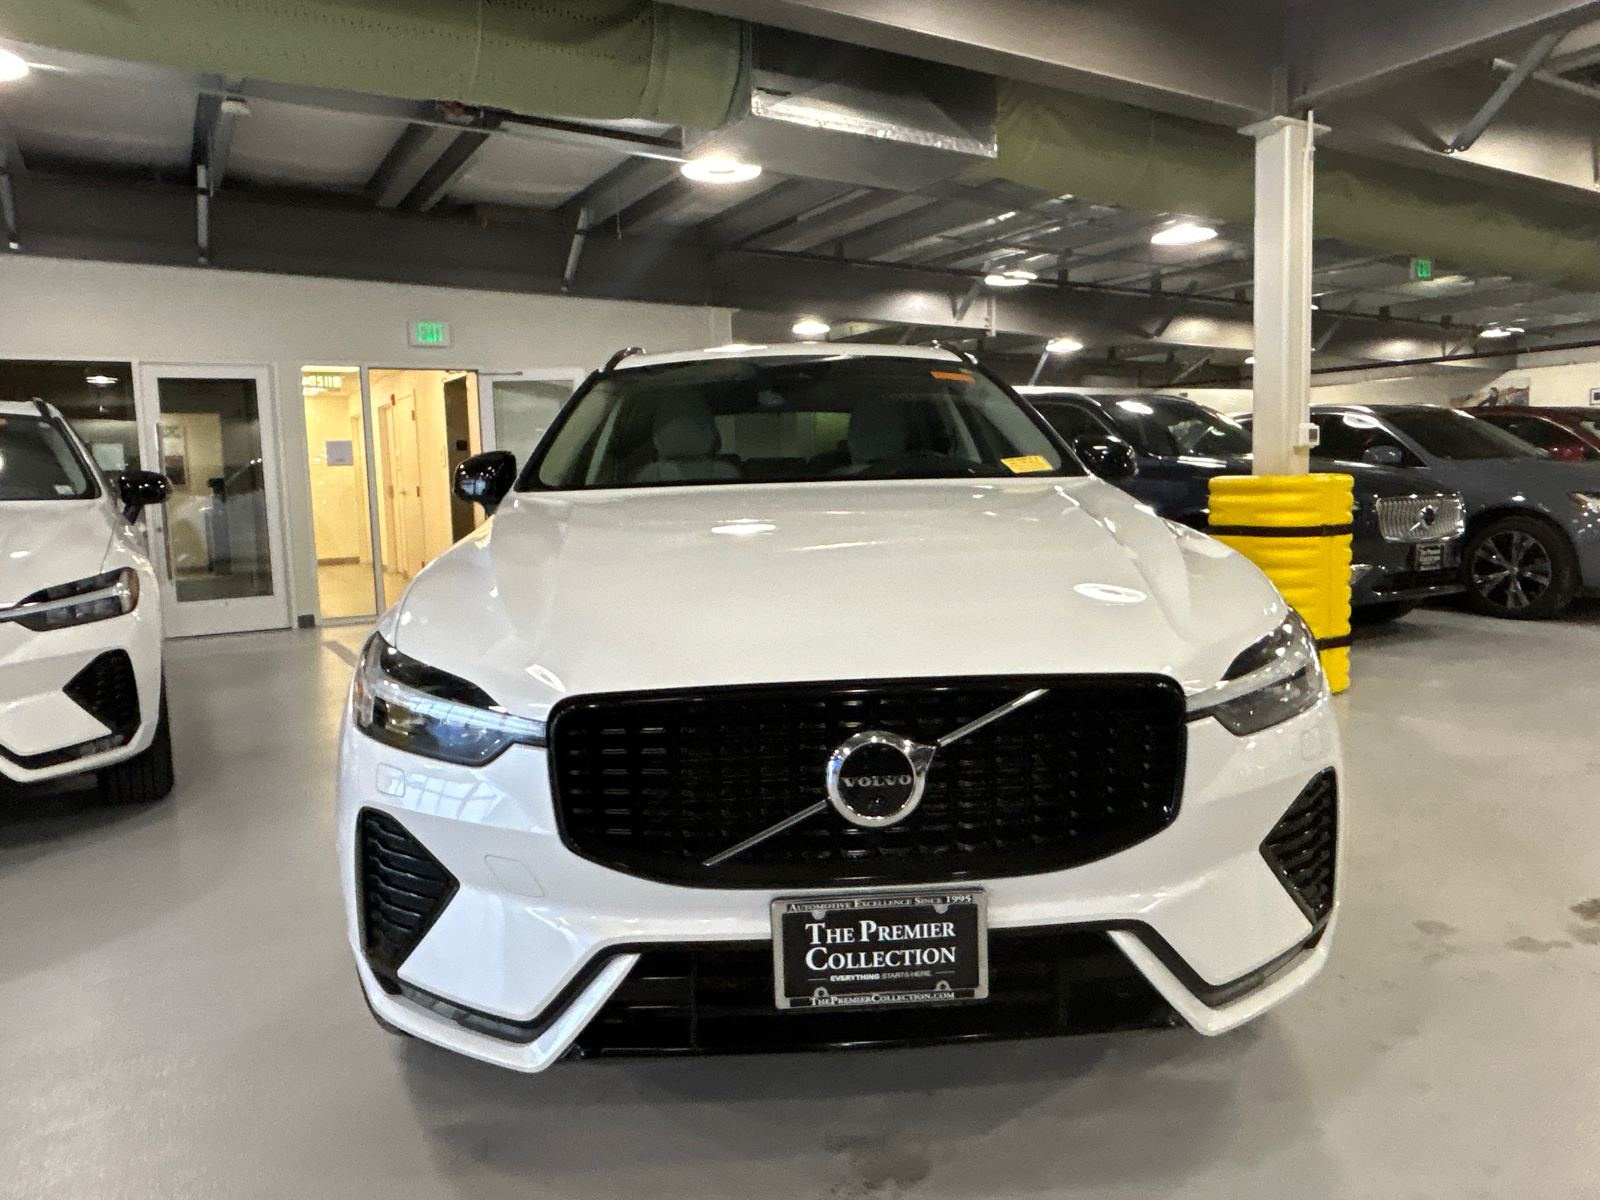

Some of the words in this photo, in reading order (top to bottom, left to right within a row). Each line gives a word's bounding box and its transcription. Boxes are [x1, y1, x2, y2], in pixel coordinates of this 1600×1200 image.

[417, 320, 443, 343] EXIT
[842, 775, 912, 788] VOLVO
[945, 894, 972, 903] 1995
[830, 973, 880, 982] EVERYTHING
